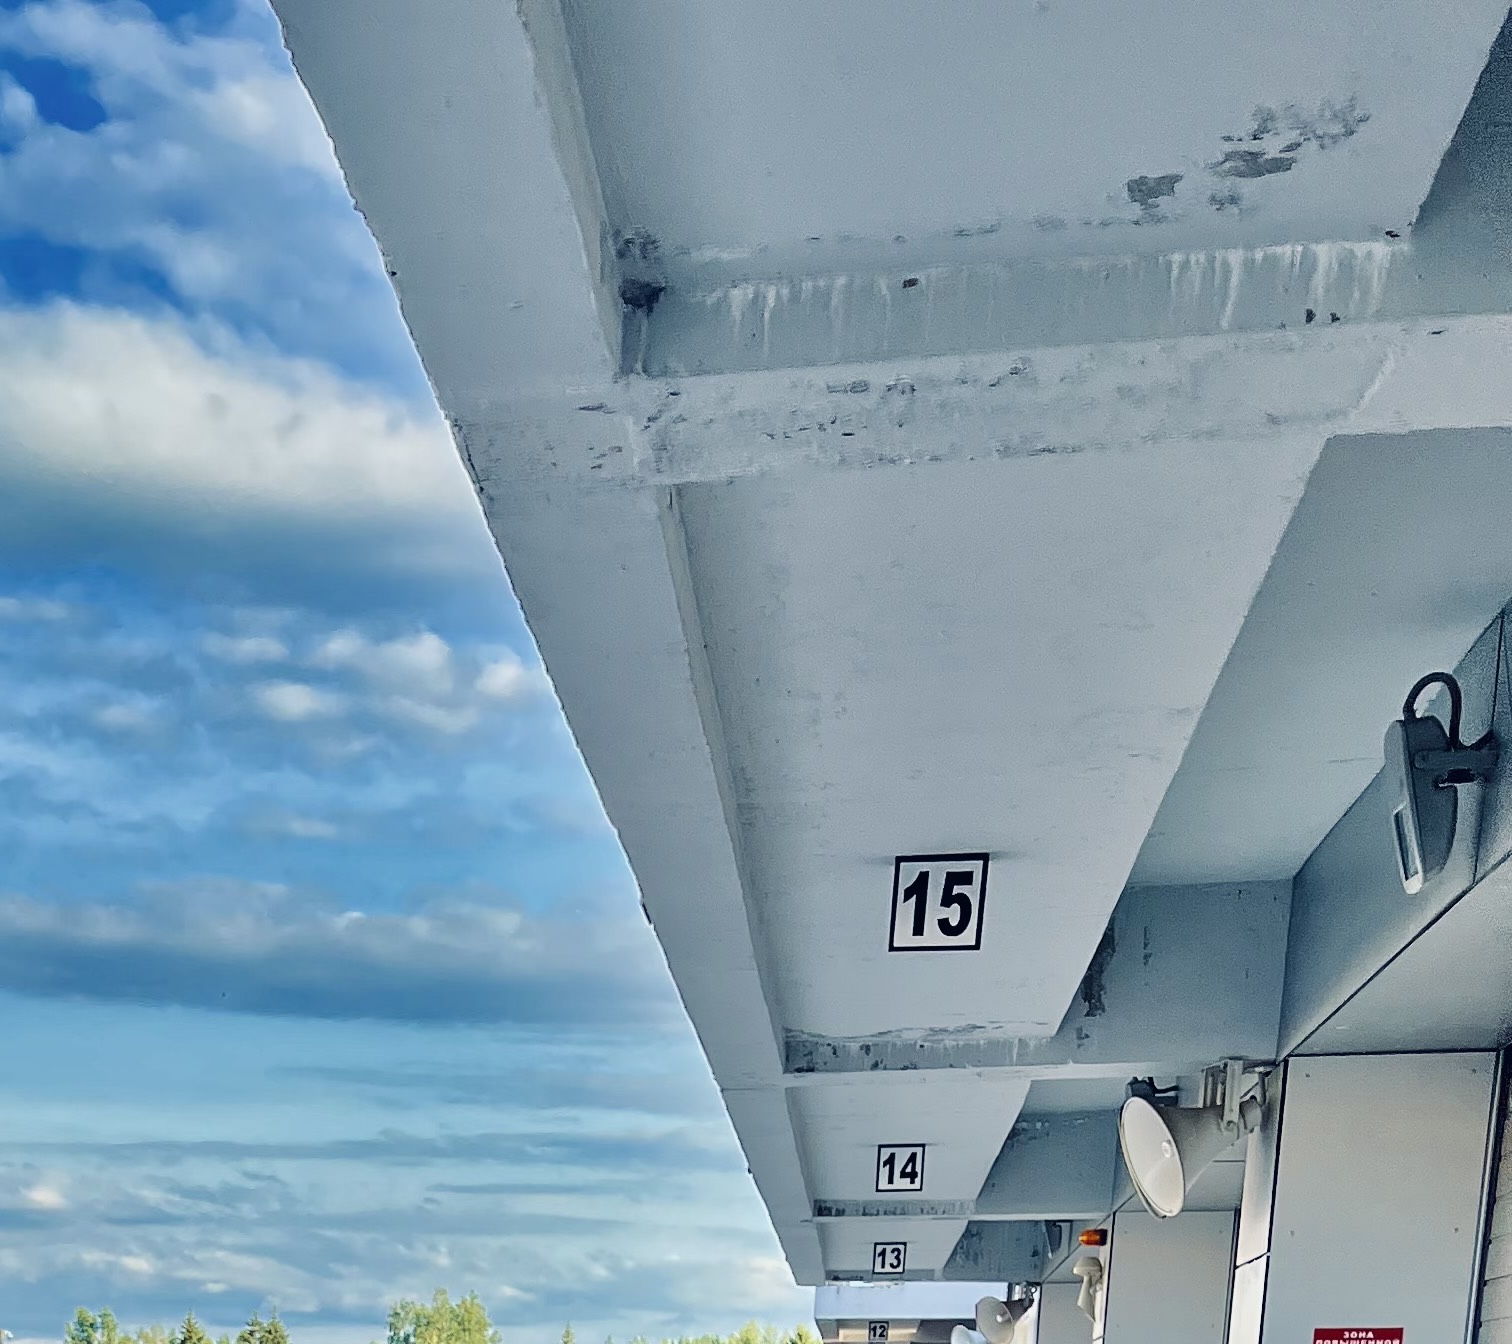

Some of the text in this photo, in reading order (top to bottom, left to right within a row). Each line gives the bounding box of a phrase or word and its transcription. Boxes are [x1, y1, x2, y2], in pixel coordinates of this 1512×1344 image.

[901, 870, 975, 938] 15
[881, 1151, 919, 1185] 14
[876, 1247, 902, 1269] 13
[870, 1324, 887, 1338] 12
[1343, 1331, 1374, 1339] ЗОНА
